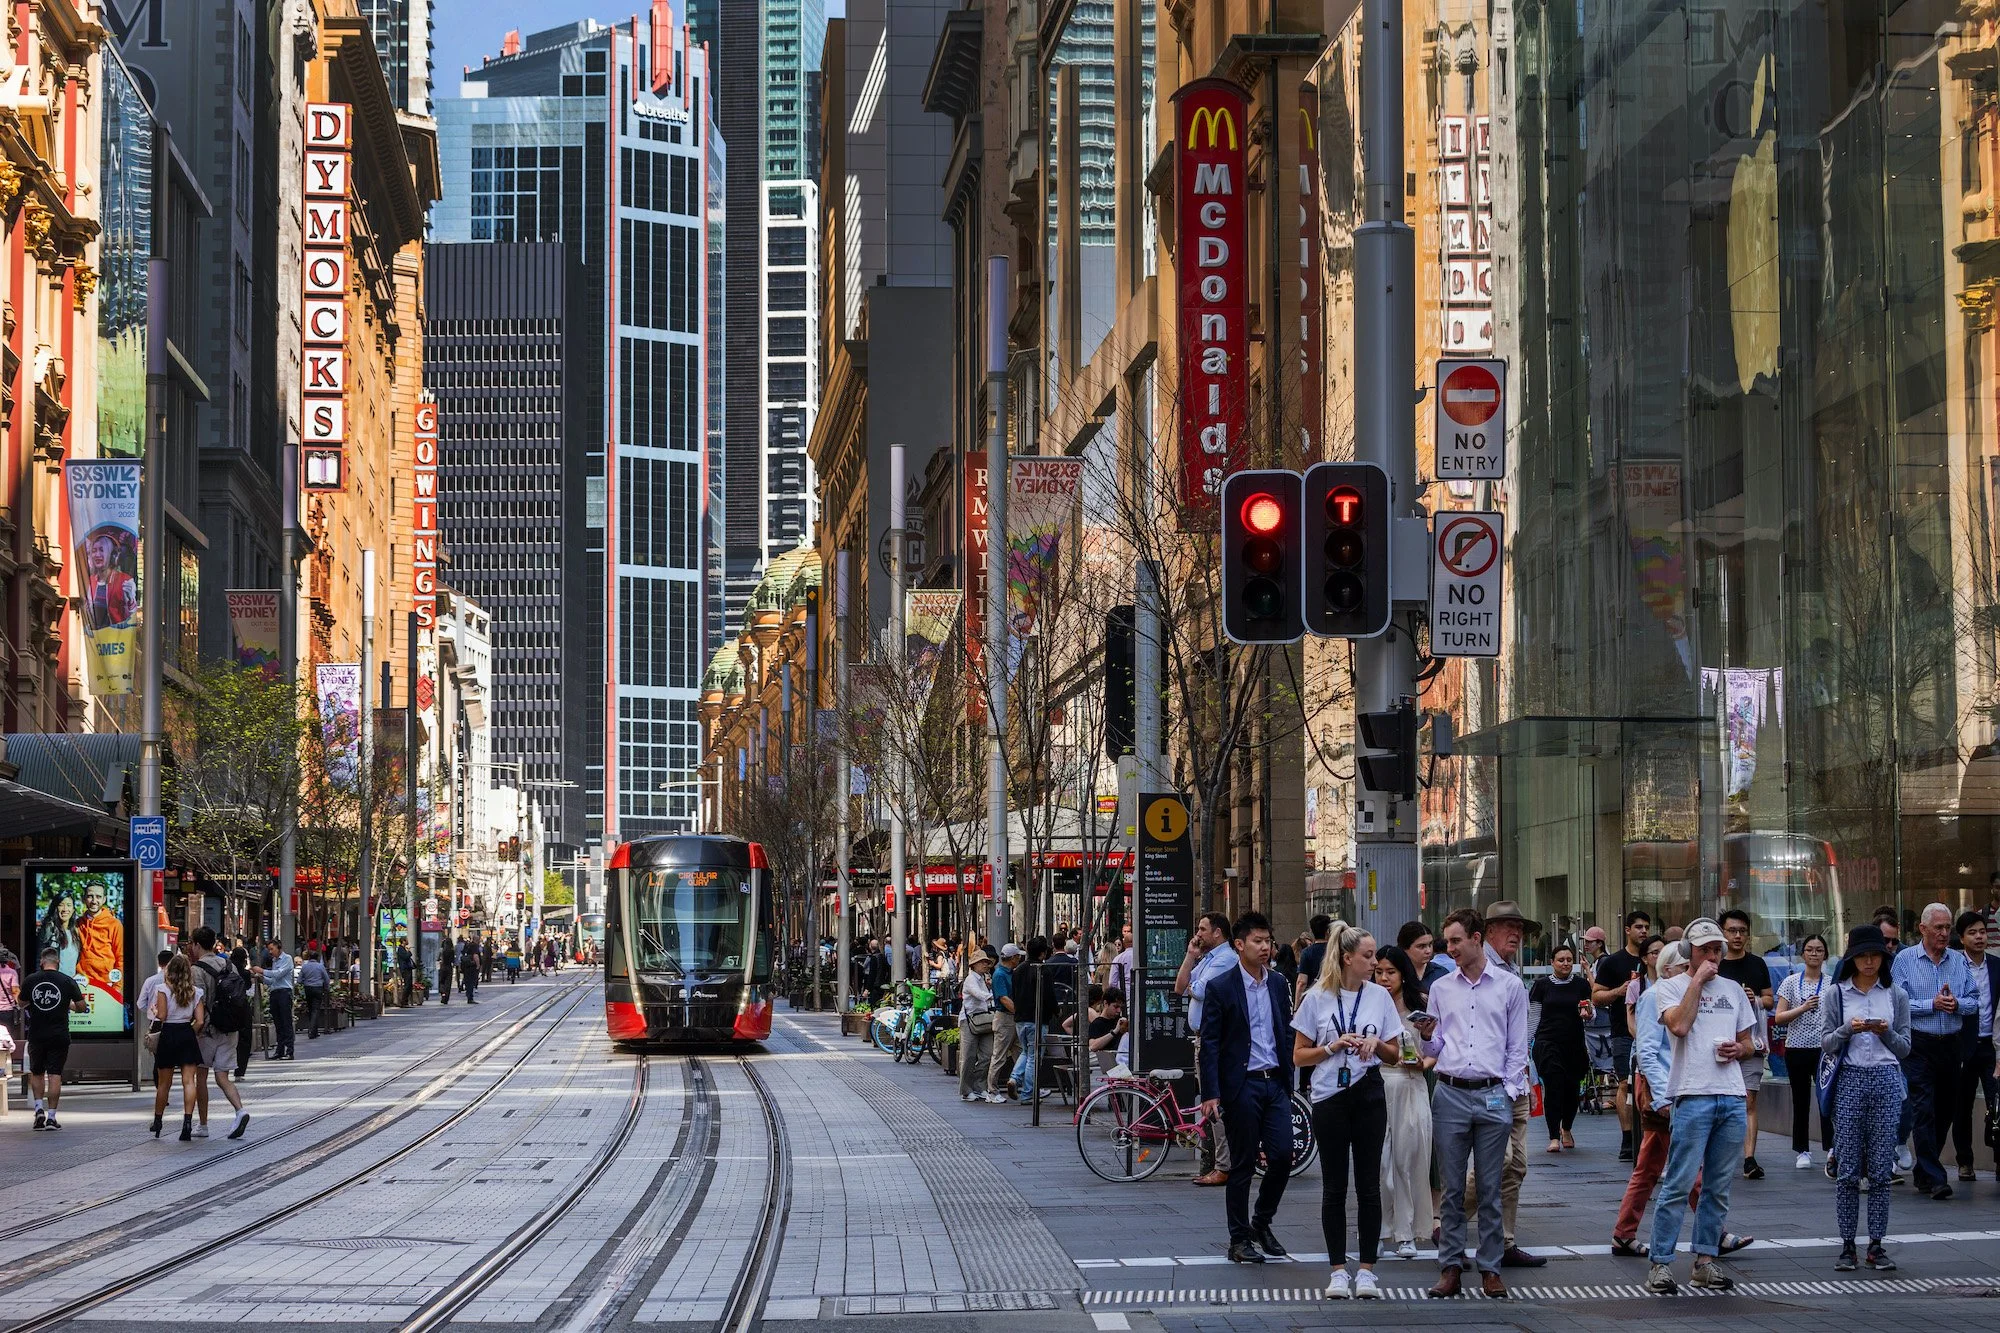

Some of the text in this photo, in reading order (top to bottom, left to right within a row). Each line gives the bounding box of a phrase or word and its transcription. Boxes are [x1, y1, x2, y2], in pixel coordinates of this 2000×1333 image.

[646, 103, 688, 121] breathe
[310, 110, 341, 437] DYMOCKS
[1194, 163, 1233, 497] McDonald's
[1455, 432, 1486, 450] NO
[1441, 455, 1499, 471] ENTRY
[72, 466, 119, 482] SXSW
[73, 483, 137, 499] SYDNEY
[101, 502, 136, 510] OCT 15-22
[416, 408, 435, 627] GOWINGS
[228, 594, 263, 606] SXSW
[1449, 584, 1485, 605] NO
[230, 606, 277, 618] SYDNEY
[1439, 611, 1493, 627] RIGHT
[1441, 632, 1491, 648] TURN
[320, 676, 356, 685] SYDNEY
[139, 844, 157, 859] 20
[678, 871, 718, 880] CIRCULAR
[687, 879, 710, 887] QUAY
[727, 955, 740, 966] 57
